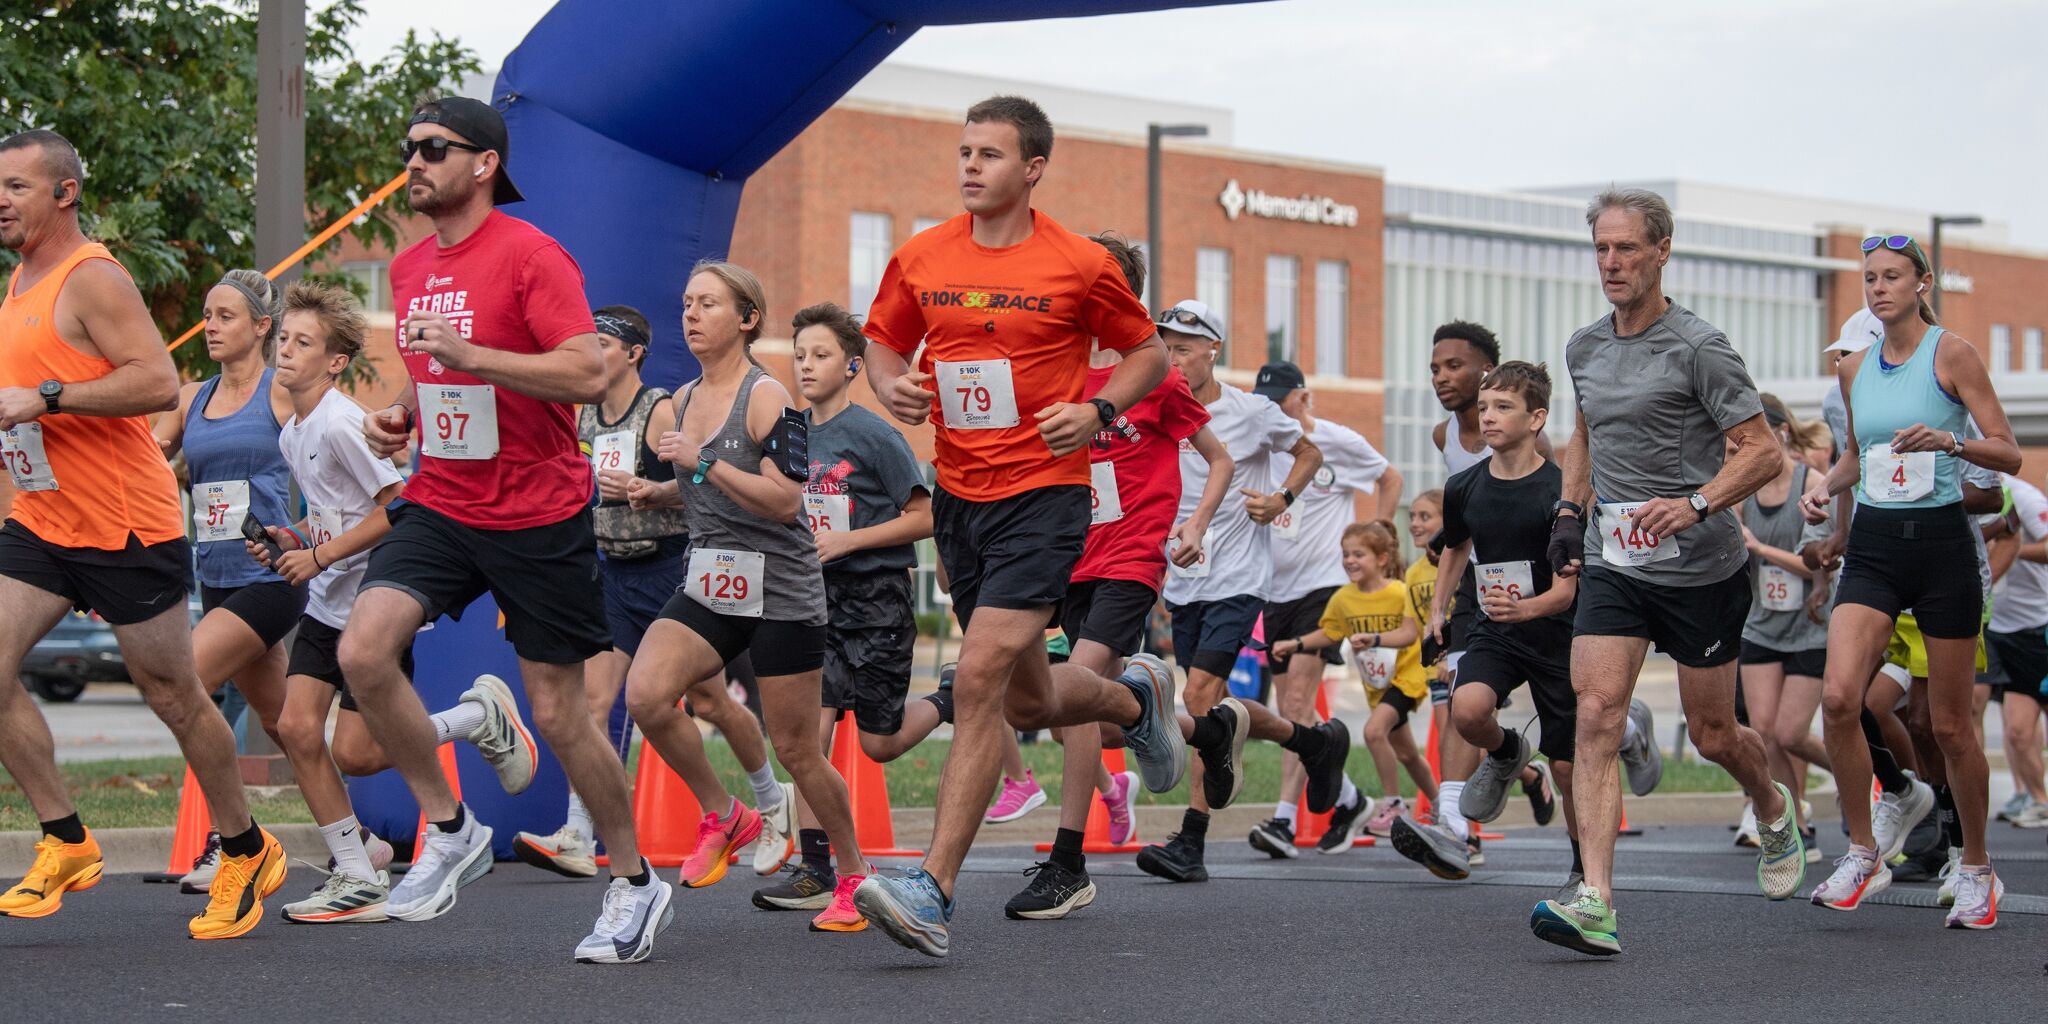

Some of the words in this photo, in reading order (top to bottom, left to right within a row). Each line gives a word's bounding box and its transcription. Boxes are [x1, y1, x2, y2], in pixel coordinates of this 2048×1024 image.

[1246, 189, 1320, 222] Memorial
[1322, 197, 1358, 227] Care
[408, 291, 467, 317] STARS
[957, 387, 991, 412] 79
[436, 412, 470, 440] 97
[5, 450, 32, 475] 73
[600, 450, 621, 469] 78
[1892, 465, 1906, 487] 4
[207, 504, 229, 526] 57
[1613, 527, 1659, 550] 140
[700, 572, 748, 600] 129
[1766, 583, 1787, 600] 25
